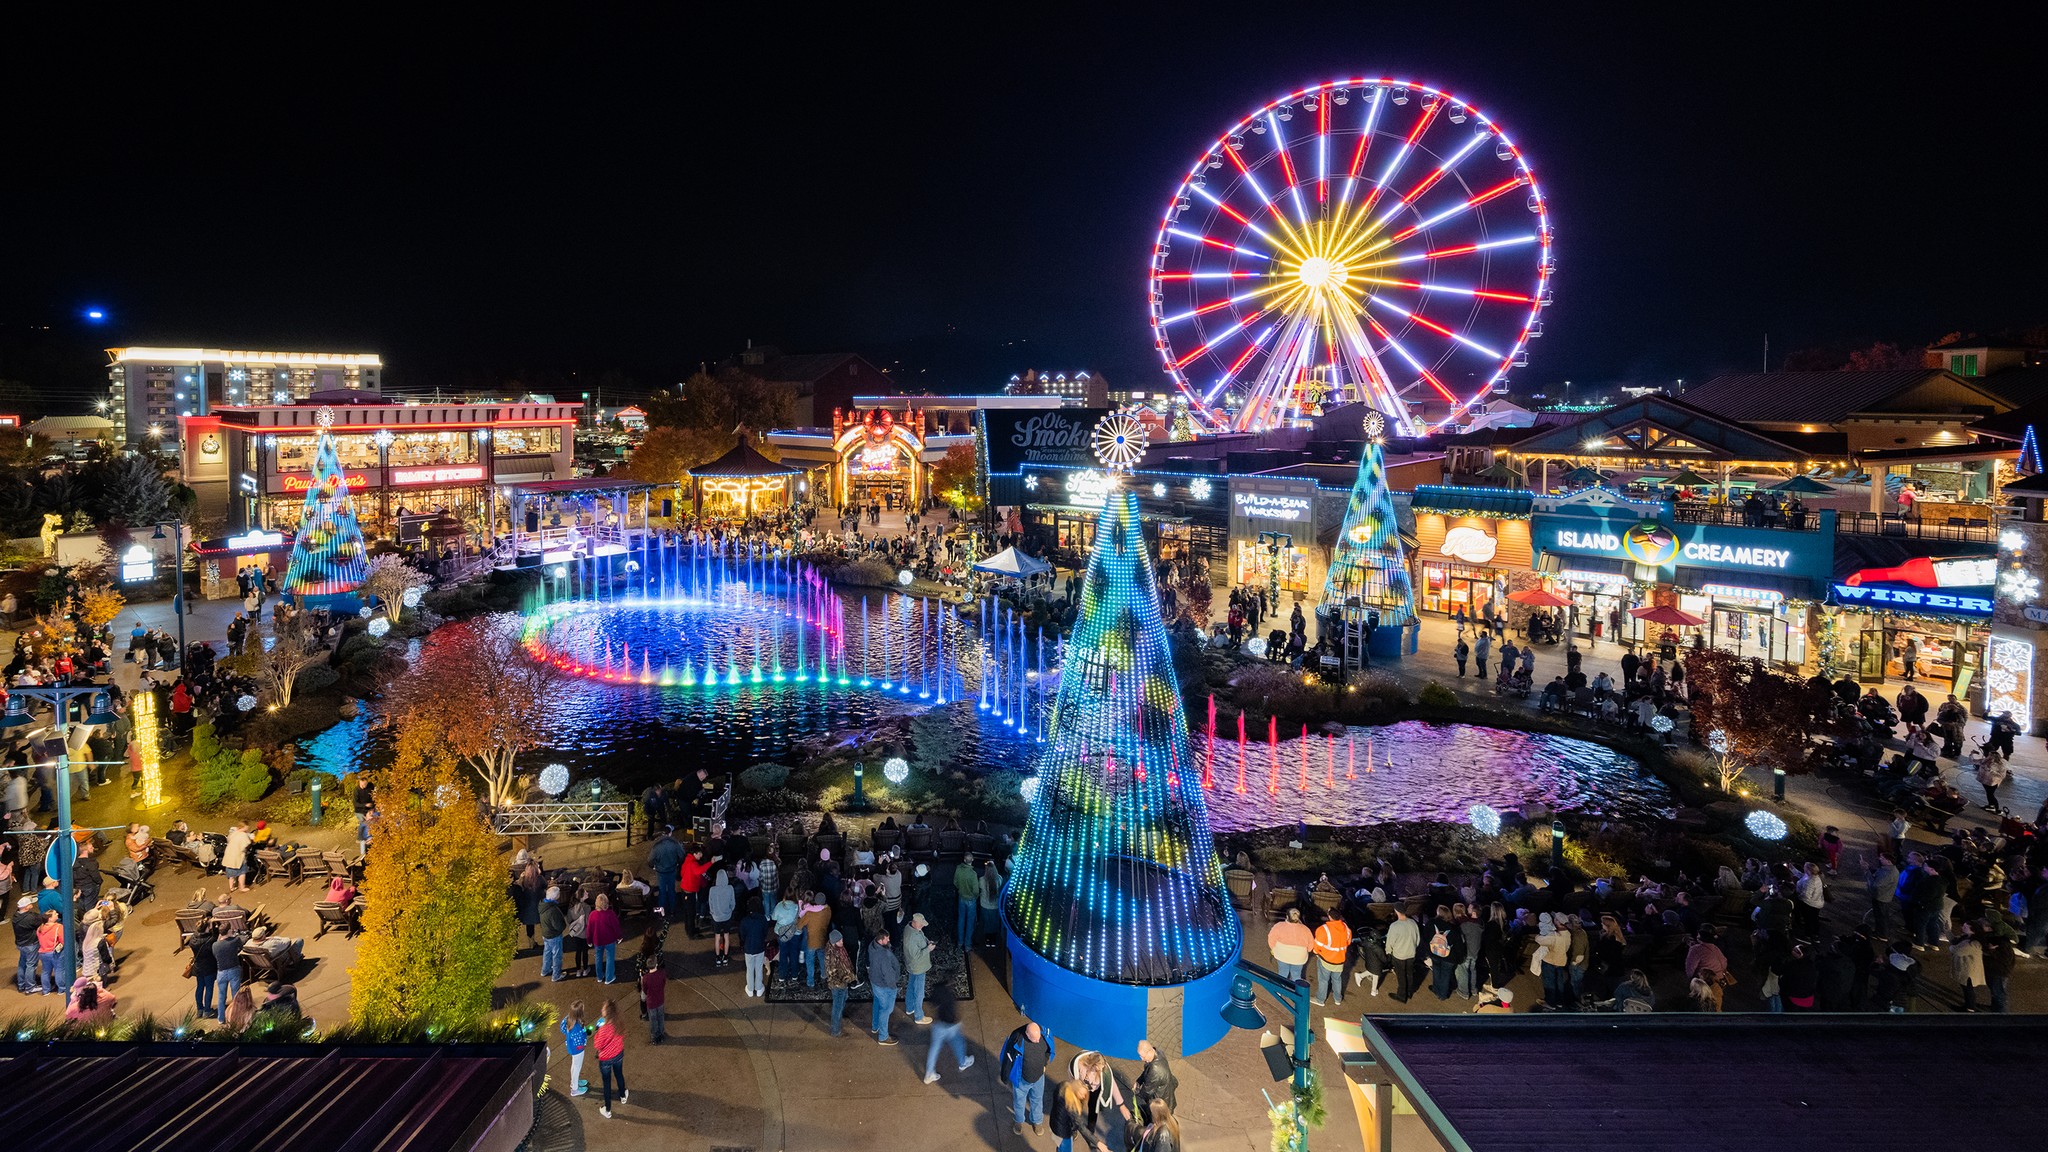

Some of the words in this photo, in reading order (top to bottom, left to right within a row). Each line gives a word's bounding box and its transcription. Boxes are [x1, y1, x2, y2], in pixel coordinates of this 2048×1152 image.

[1043, 412, 1071, 430] Ole
[1011, 416, 1093, 451] Smoky
[1025, 448, 1087, 461] Moonshine
[395, 471, 435, 483] FAMILY
[435, 468, 482, 481] KITCHEN
[1244, 506, 1300, 519] WORKSHOP
[1558, 531, 1619, 551] ISLAND
[1684, 543, 1789, 567] CREAMERY
[1563, 571, 1625, 584] DELICIOUS
[1706, 586, 1778, 601] DESSERTS
[1834, 585, 1994, 612] WINER
